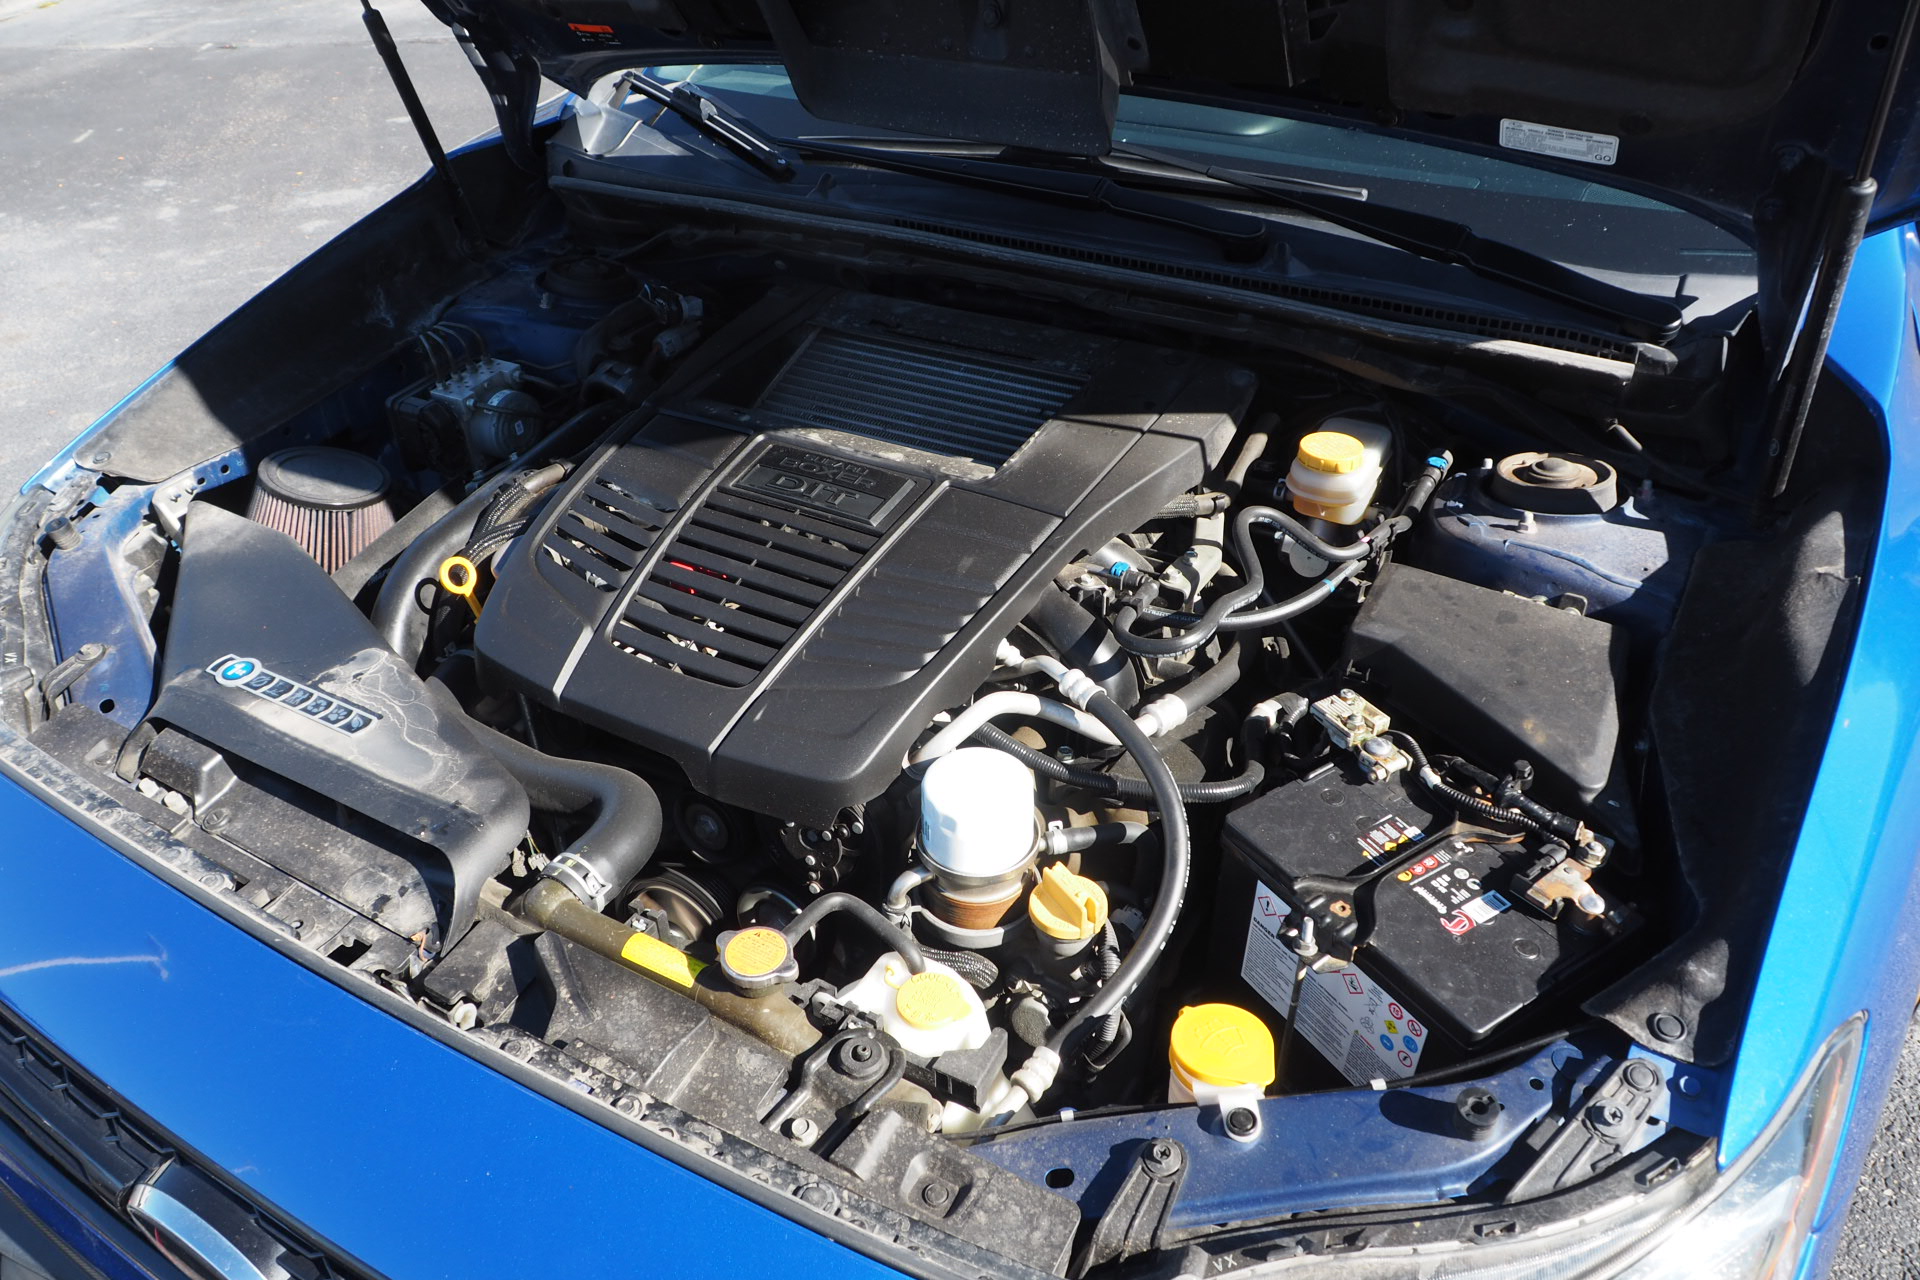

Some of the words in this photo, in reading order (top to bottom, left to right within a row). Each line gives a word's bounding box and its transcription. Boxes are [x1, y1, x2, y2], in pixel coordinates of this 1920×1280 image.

[779, 456, 876, 489] BOXER
[767, 474, 861, 506] DIT
[1253, 916, 1275, 939] DANGER
[1212, 1254, 1238, 1272] VX
